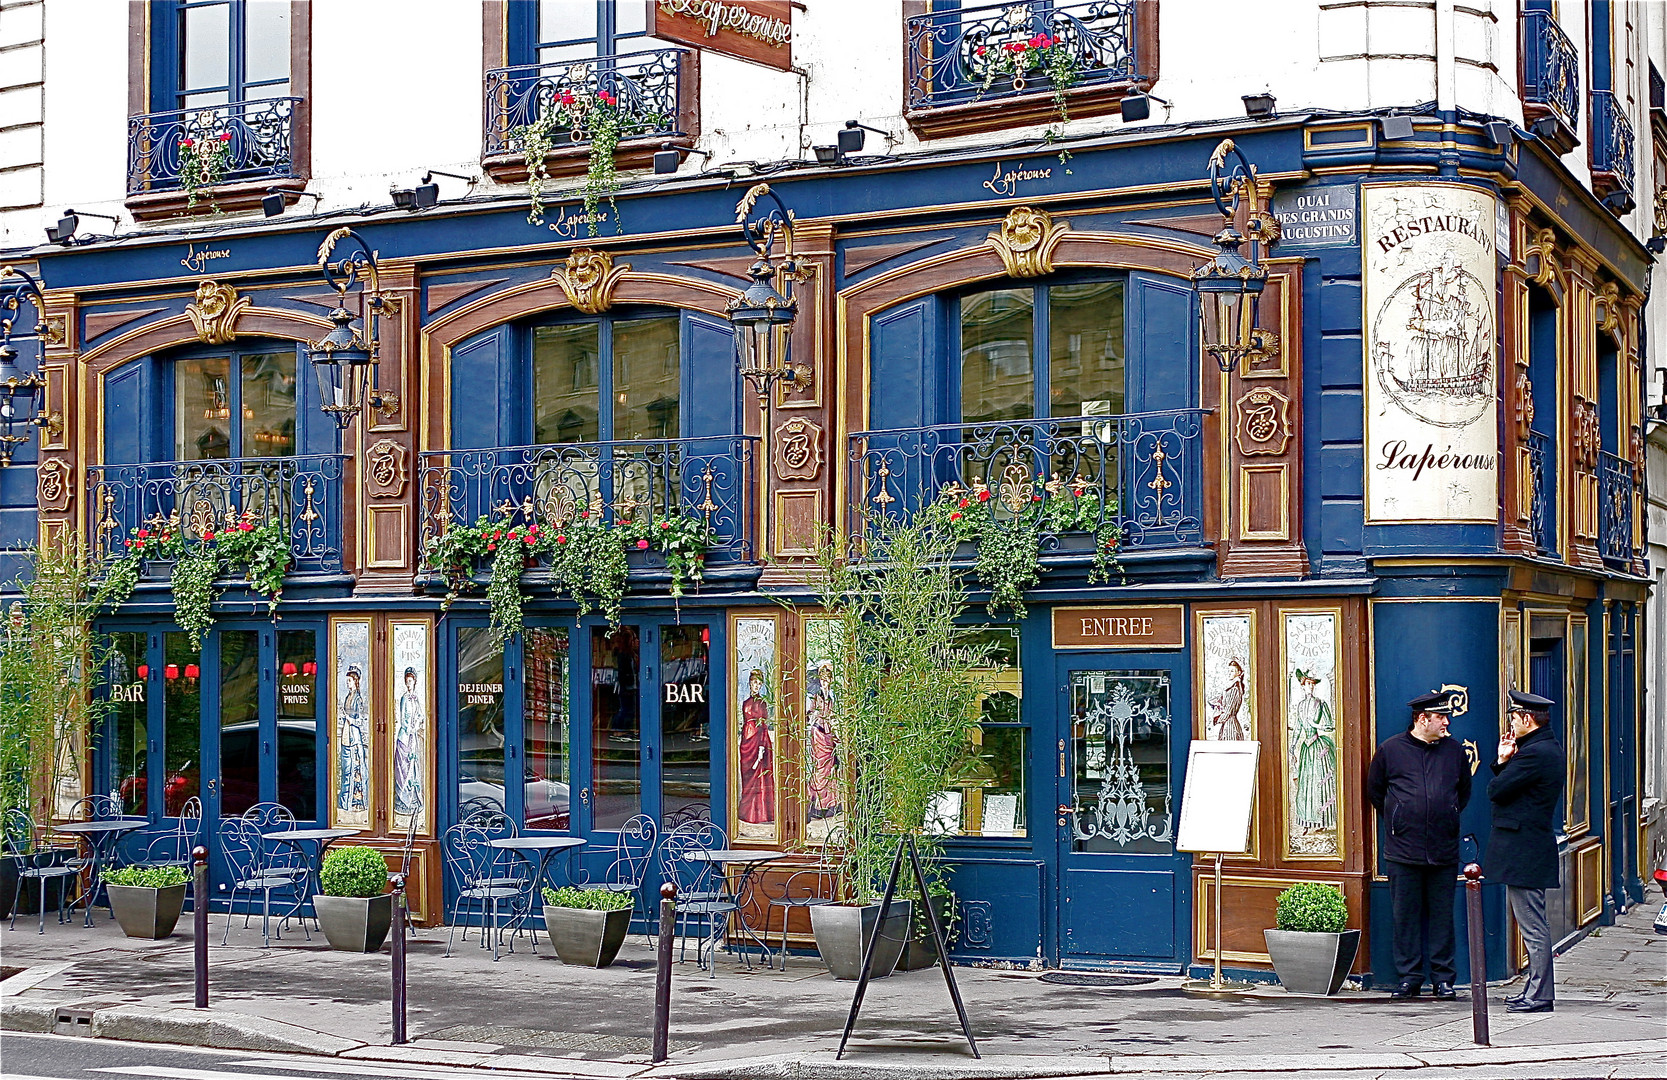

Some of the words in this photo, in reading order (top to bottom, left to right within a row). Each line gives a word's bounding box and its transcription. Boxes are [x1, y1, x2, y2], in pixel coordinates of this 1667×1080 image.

[982, 161, 1052, 197] Lapérouse
[1297, 194, 1329, 210] QUAI
[1274, 212, 1299, 224] DES
[1301, 208, 1354, 223] GRANDS
[1280, 224, 1351, 240] AUGUSTINS
[1376, 215, 1492, 256] RESTAURANT
[180, 243, 230, 273] Lapérouse
[1375, 439, 1495, 482] Lapérouse
[1080, 617, 1154, 636] ENTREE
[1304, 633, 1318, 644] EN
[112, 684, 145, 702] BAR
[281, 684, 310, 694] SALONS
[459, 683, 503, 693] DEJEUNER
[665, 683, 705, 703] BAR
[283, 695, 309, 705] PRIVES
[467, 694, 495, 705] DINER
